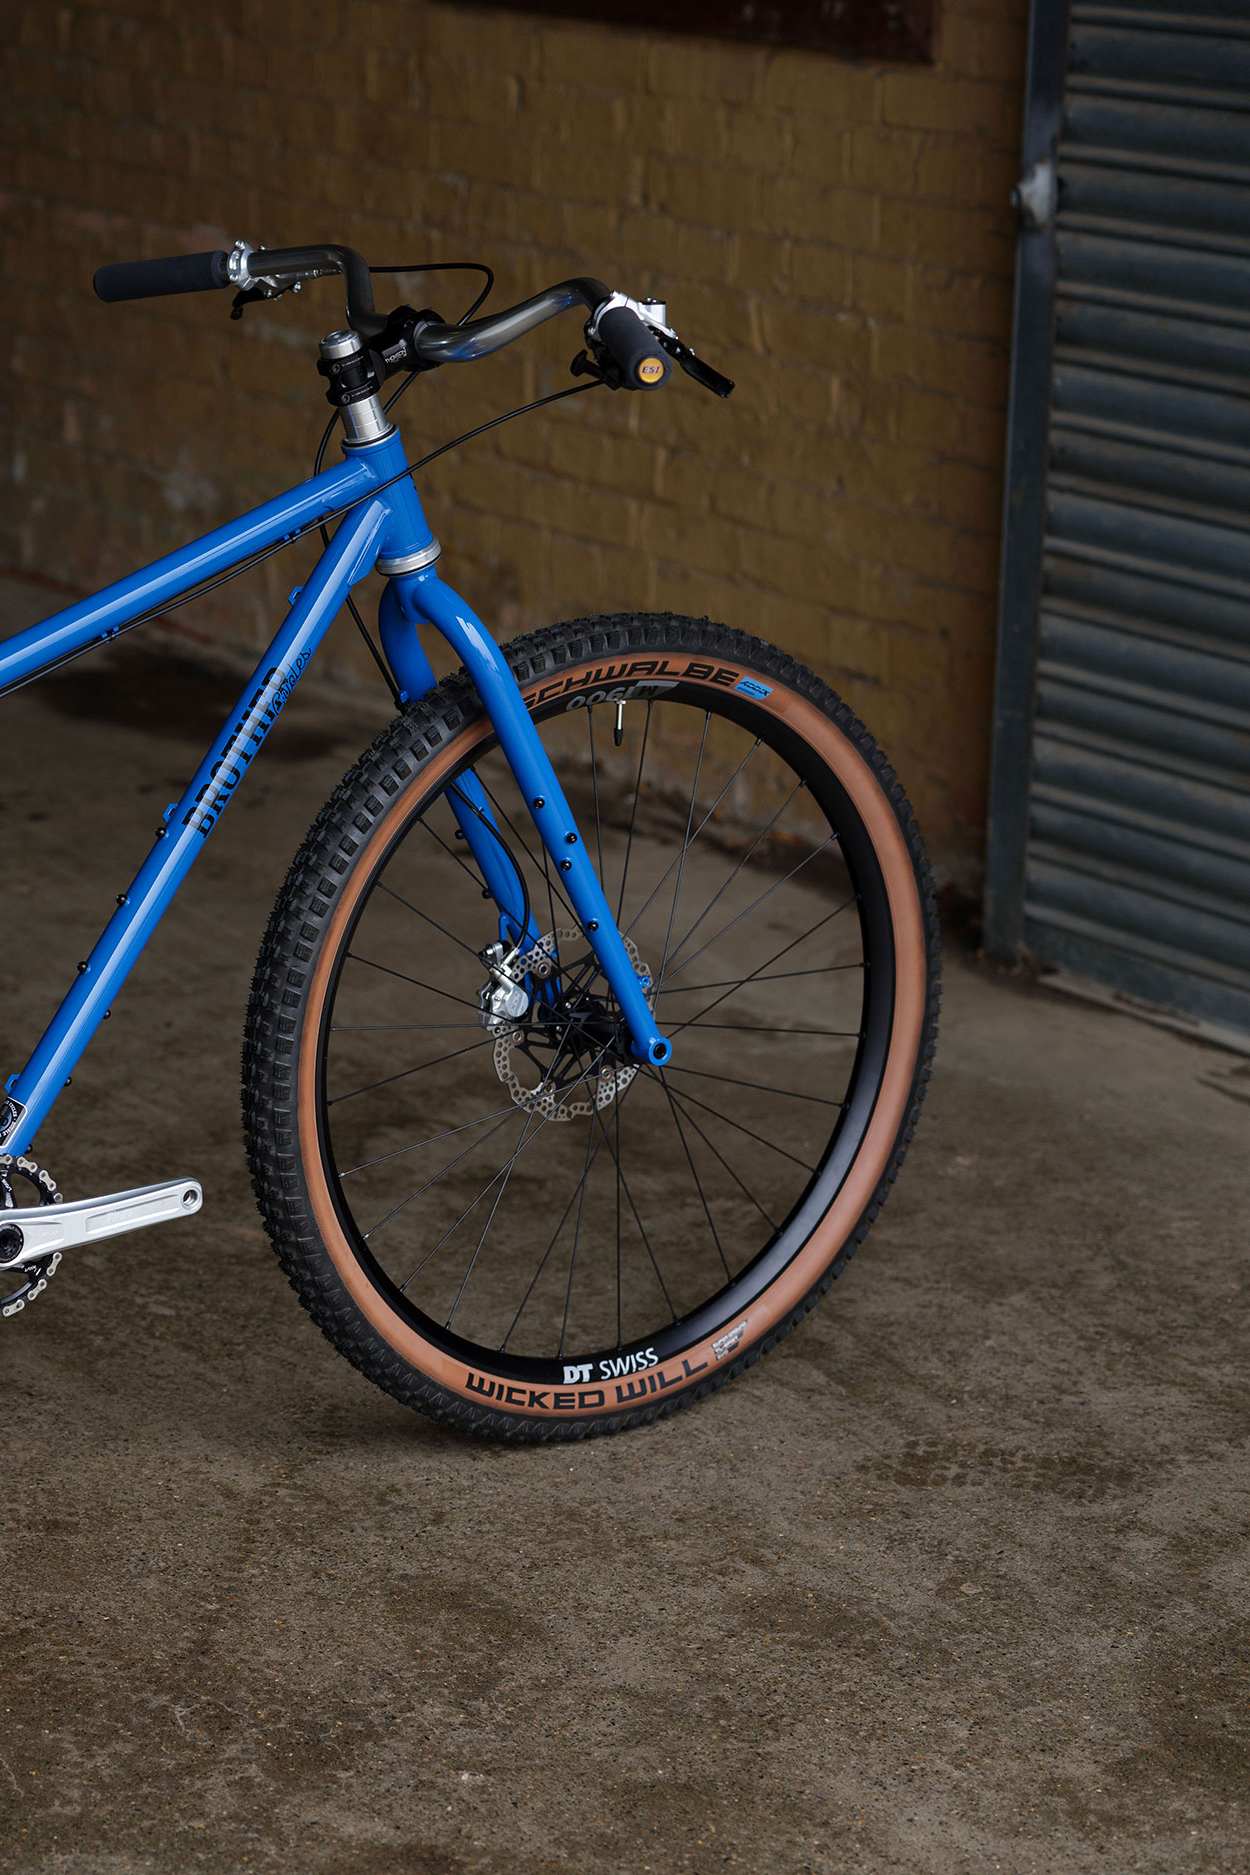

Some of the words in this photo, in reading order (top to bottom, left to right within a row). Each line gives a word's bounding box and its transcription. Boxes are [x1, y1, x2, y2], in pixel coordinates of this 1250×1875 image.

[642, 366, 660, 374] ESI
[181, 667, 286, 838] BROTHER
[465, 1372, 605, 1410] WICKED
[615, 1359, 708, 1404] WILL
[563, 1363, 595, 1385] DT
[600, 1348, 659, 1380] SWISS
